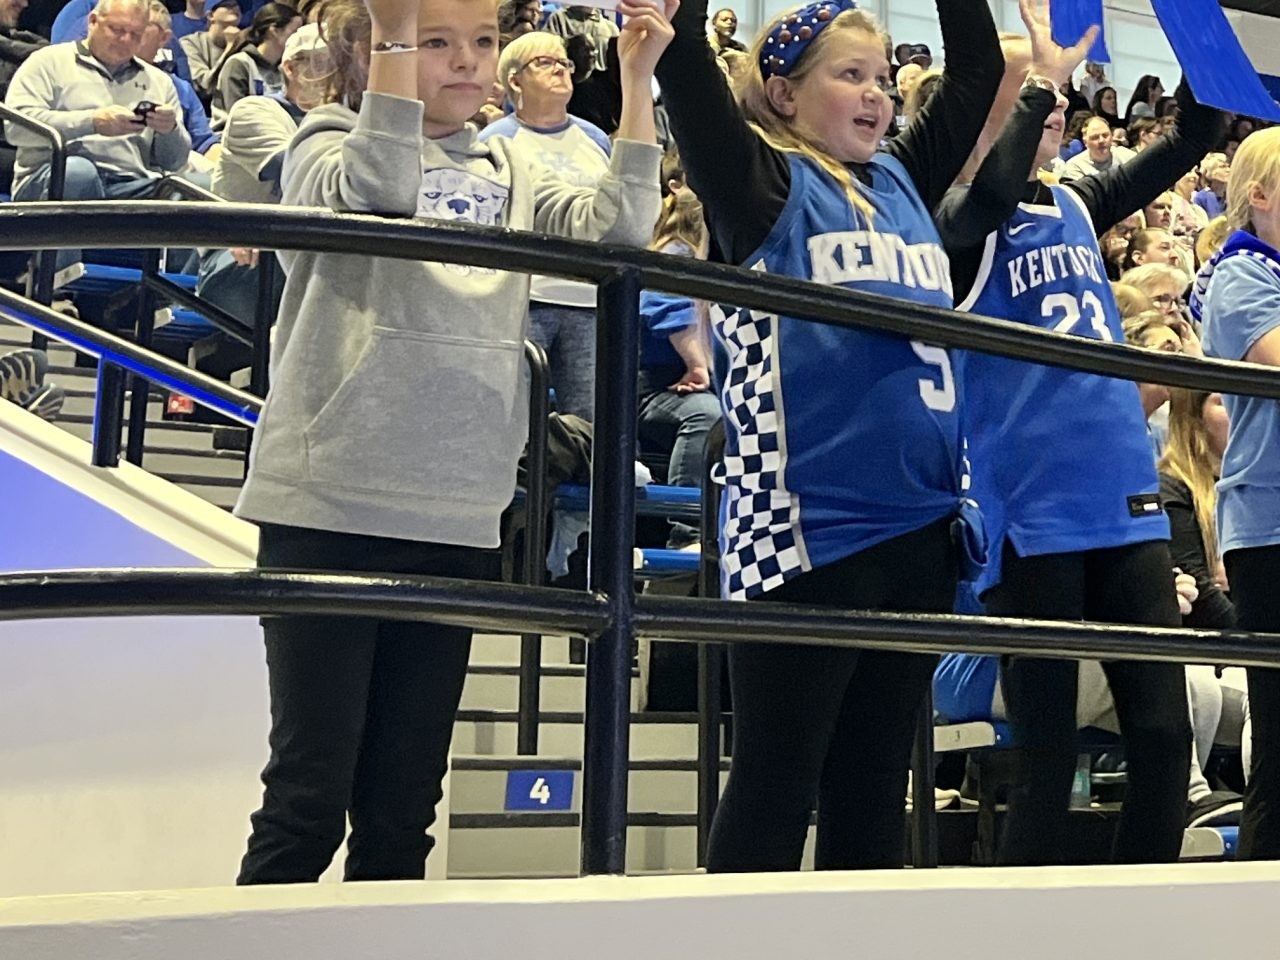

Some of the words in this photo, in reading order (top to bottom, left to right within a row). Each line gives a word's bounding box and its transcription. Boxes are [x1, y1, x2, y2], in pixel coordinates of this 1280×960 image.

[1007, 243, 1102, 298] KENTUCK
[1041, 289, 1113, 342] 23
[529, 777, 551, 805] 4
